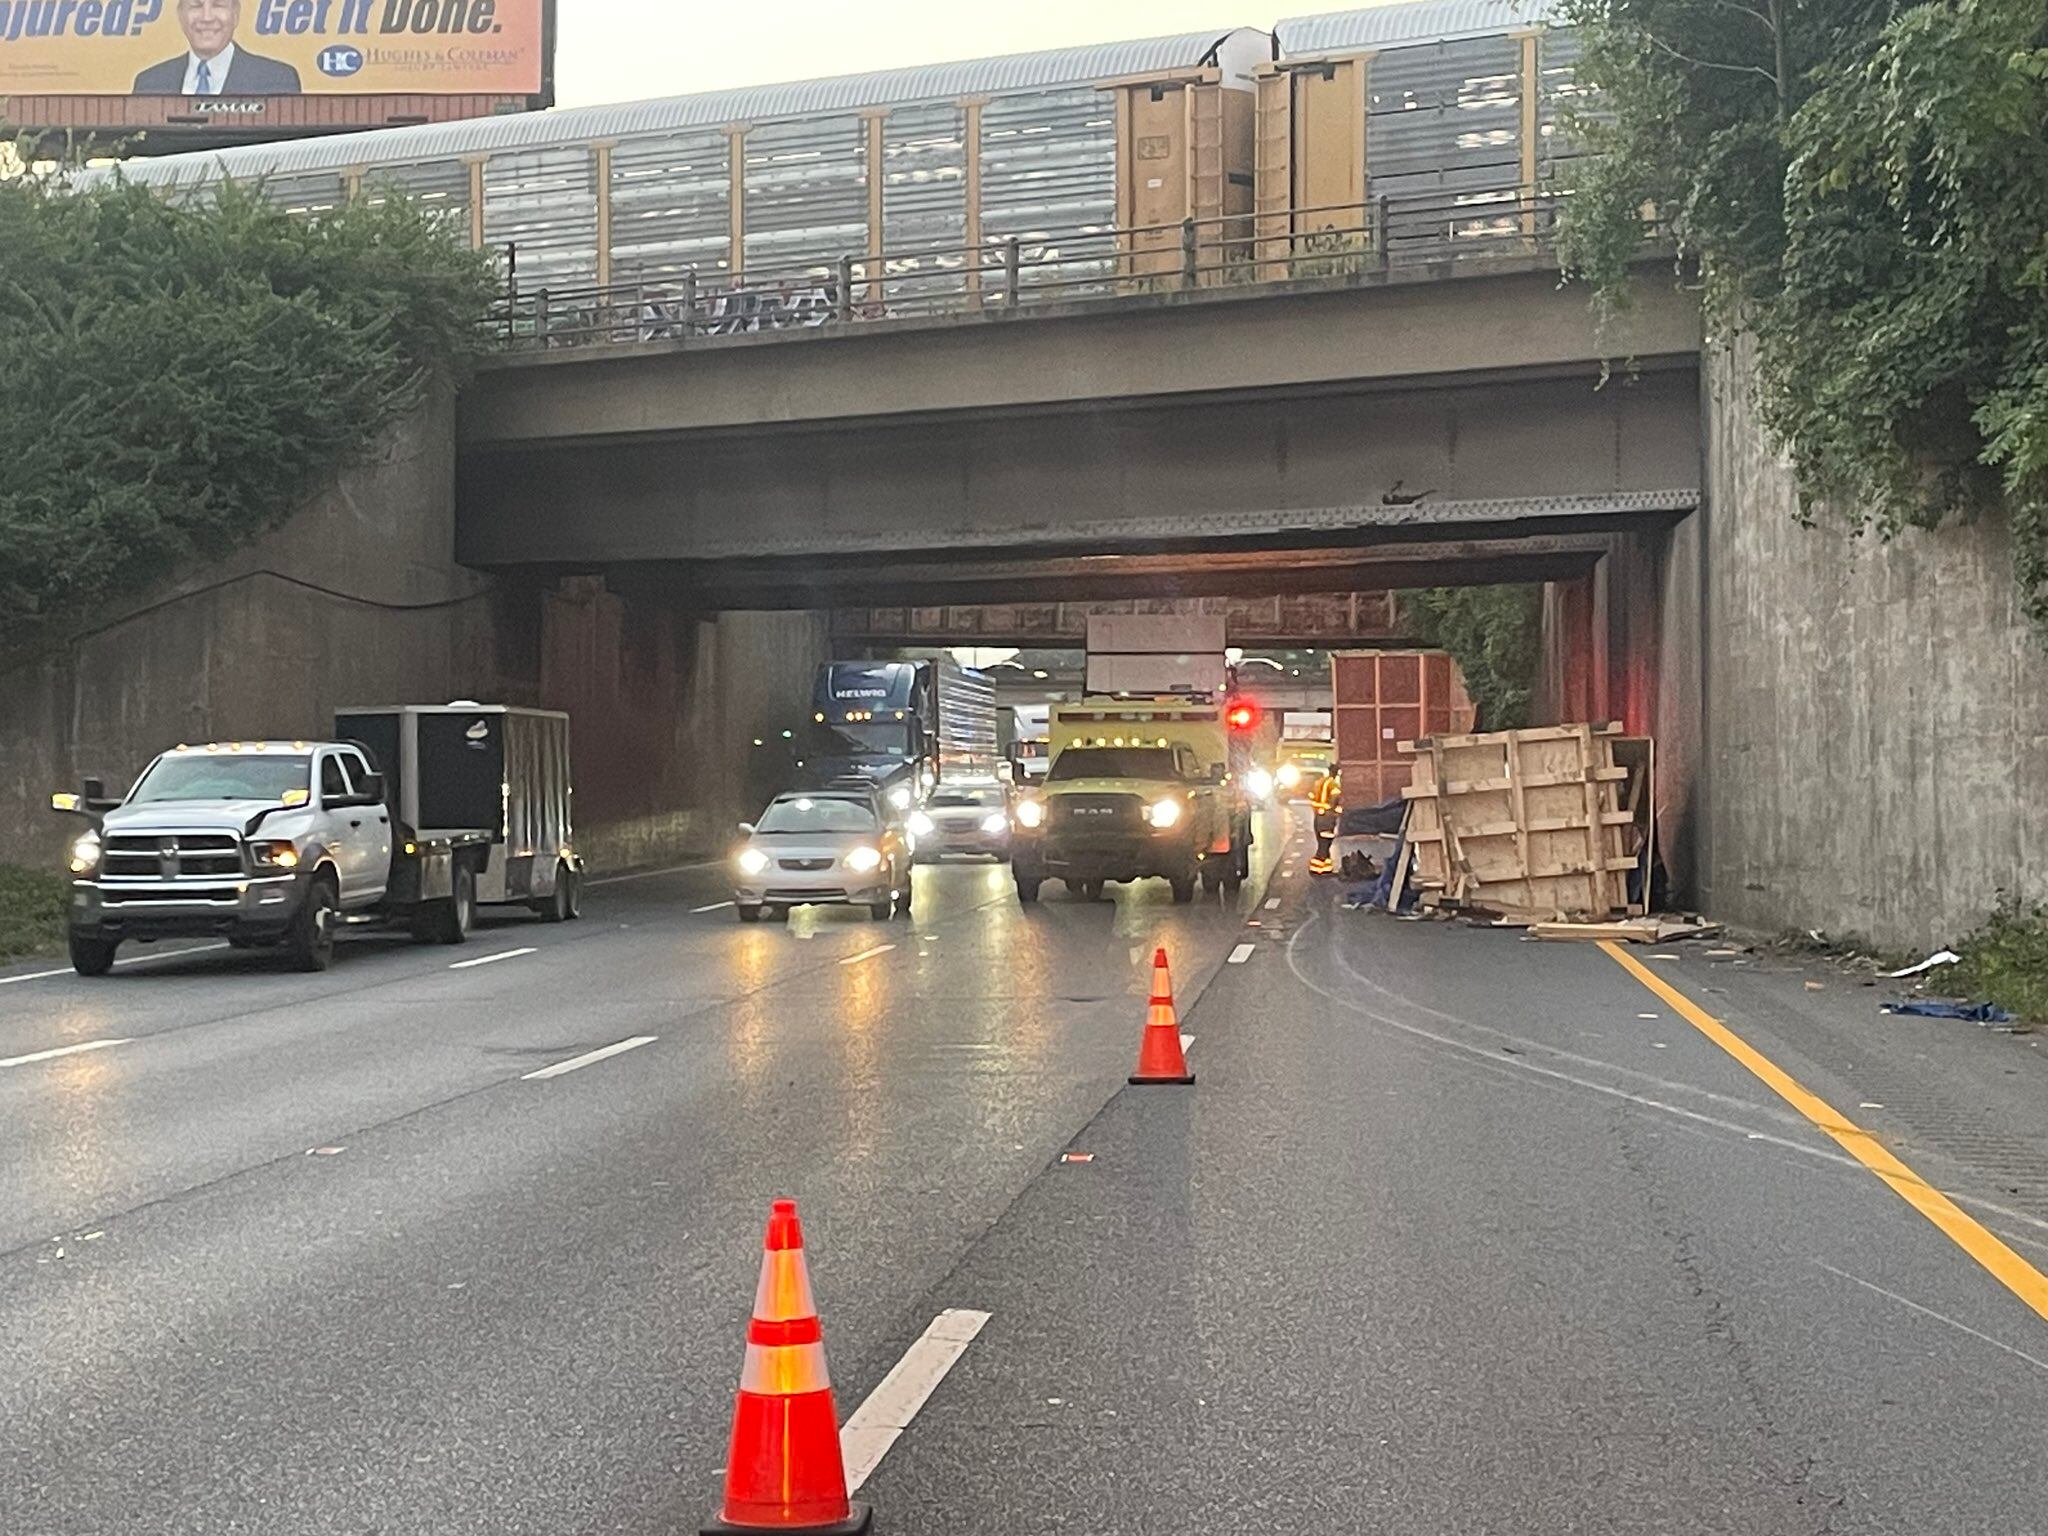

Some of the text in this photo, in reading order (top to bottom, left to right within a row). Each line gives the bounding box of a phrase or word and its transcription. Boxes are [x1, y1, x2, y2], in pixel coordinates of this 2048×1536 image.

[255, 0, 333, 35] Get
[379, 0, 502, 34] Done.
[322, 52, 358, 72] HC
[199, 102, 259, 113] LAMAR
